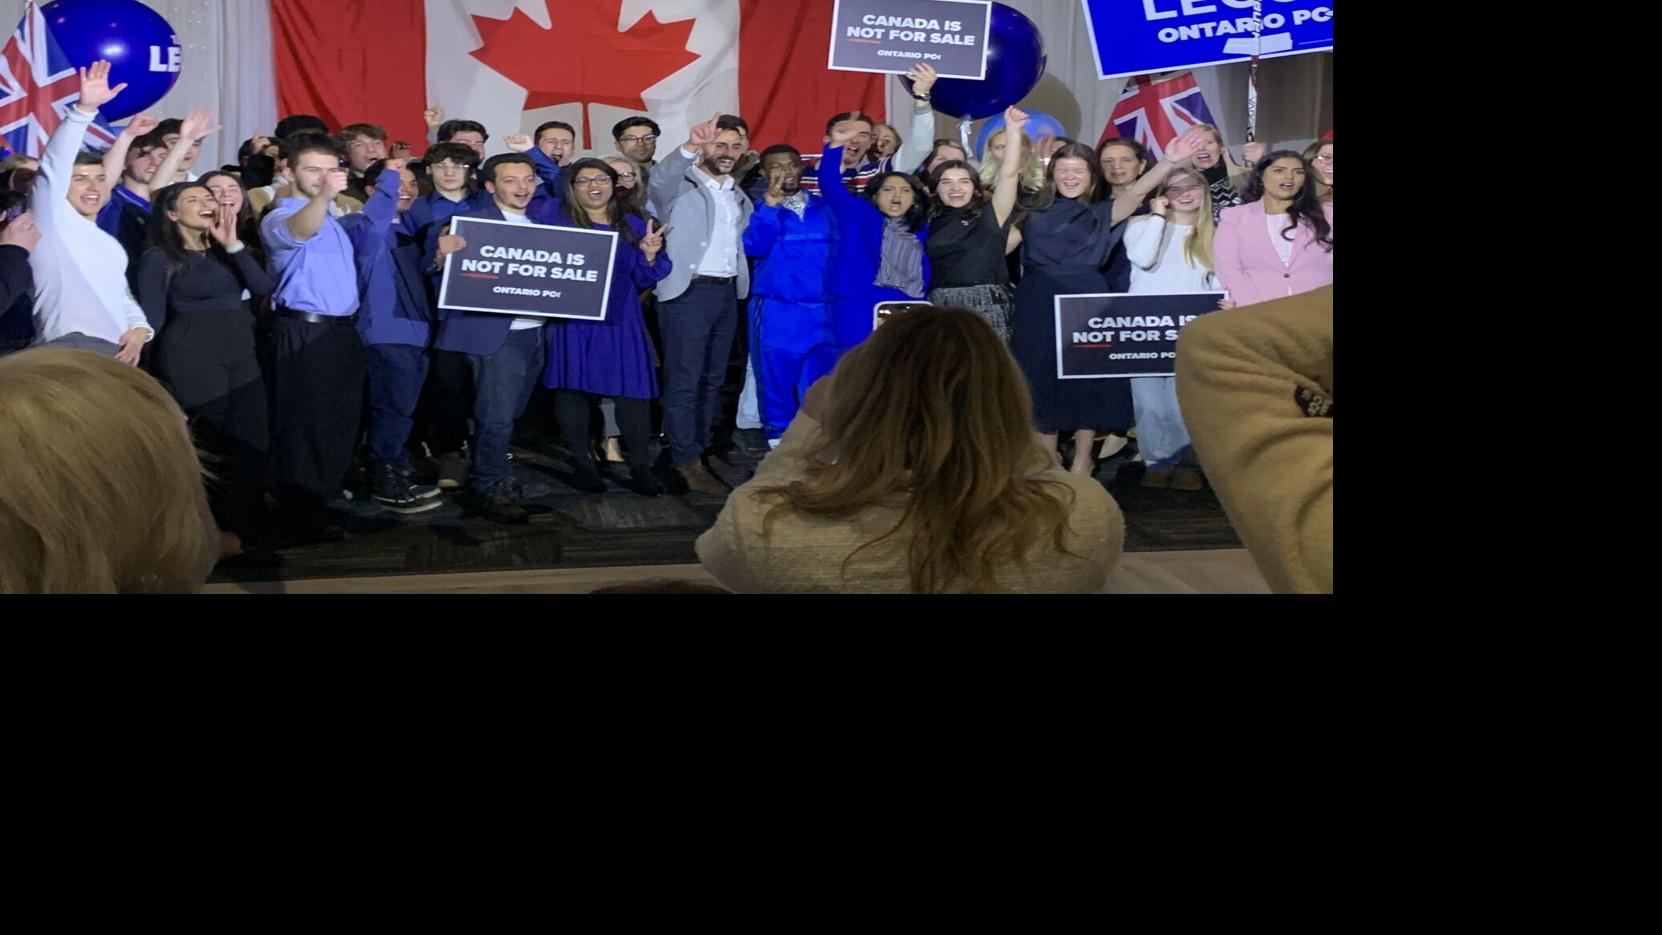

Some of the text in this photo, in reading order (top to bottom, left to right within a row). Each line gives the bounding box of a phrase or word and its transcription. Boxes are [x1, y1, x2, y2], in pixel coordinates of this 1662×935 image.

[862, 14, 962, 32] CANADA IS
[1157, 13, 1285, 43] ONTARO
[846, 26, 975, 46] NOT FOR SALE
[877, 49, 922, 59] ONTARIO
[480, 245, 585, 266] CANADA IS
[461, 259, 599, 282] NOT FOR SALE
[492, 286, 541, 297] ONTARIO
[1088, 315, 1175, 329] CANADA
[1072, 331, 1115, 343] NOT
[1119, 330, 1161, 342] FOR
[1109, 352, 1159, 360] ONTARIO
